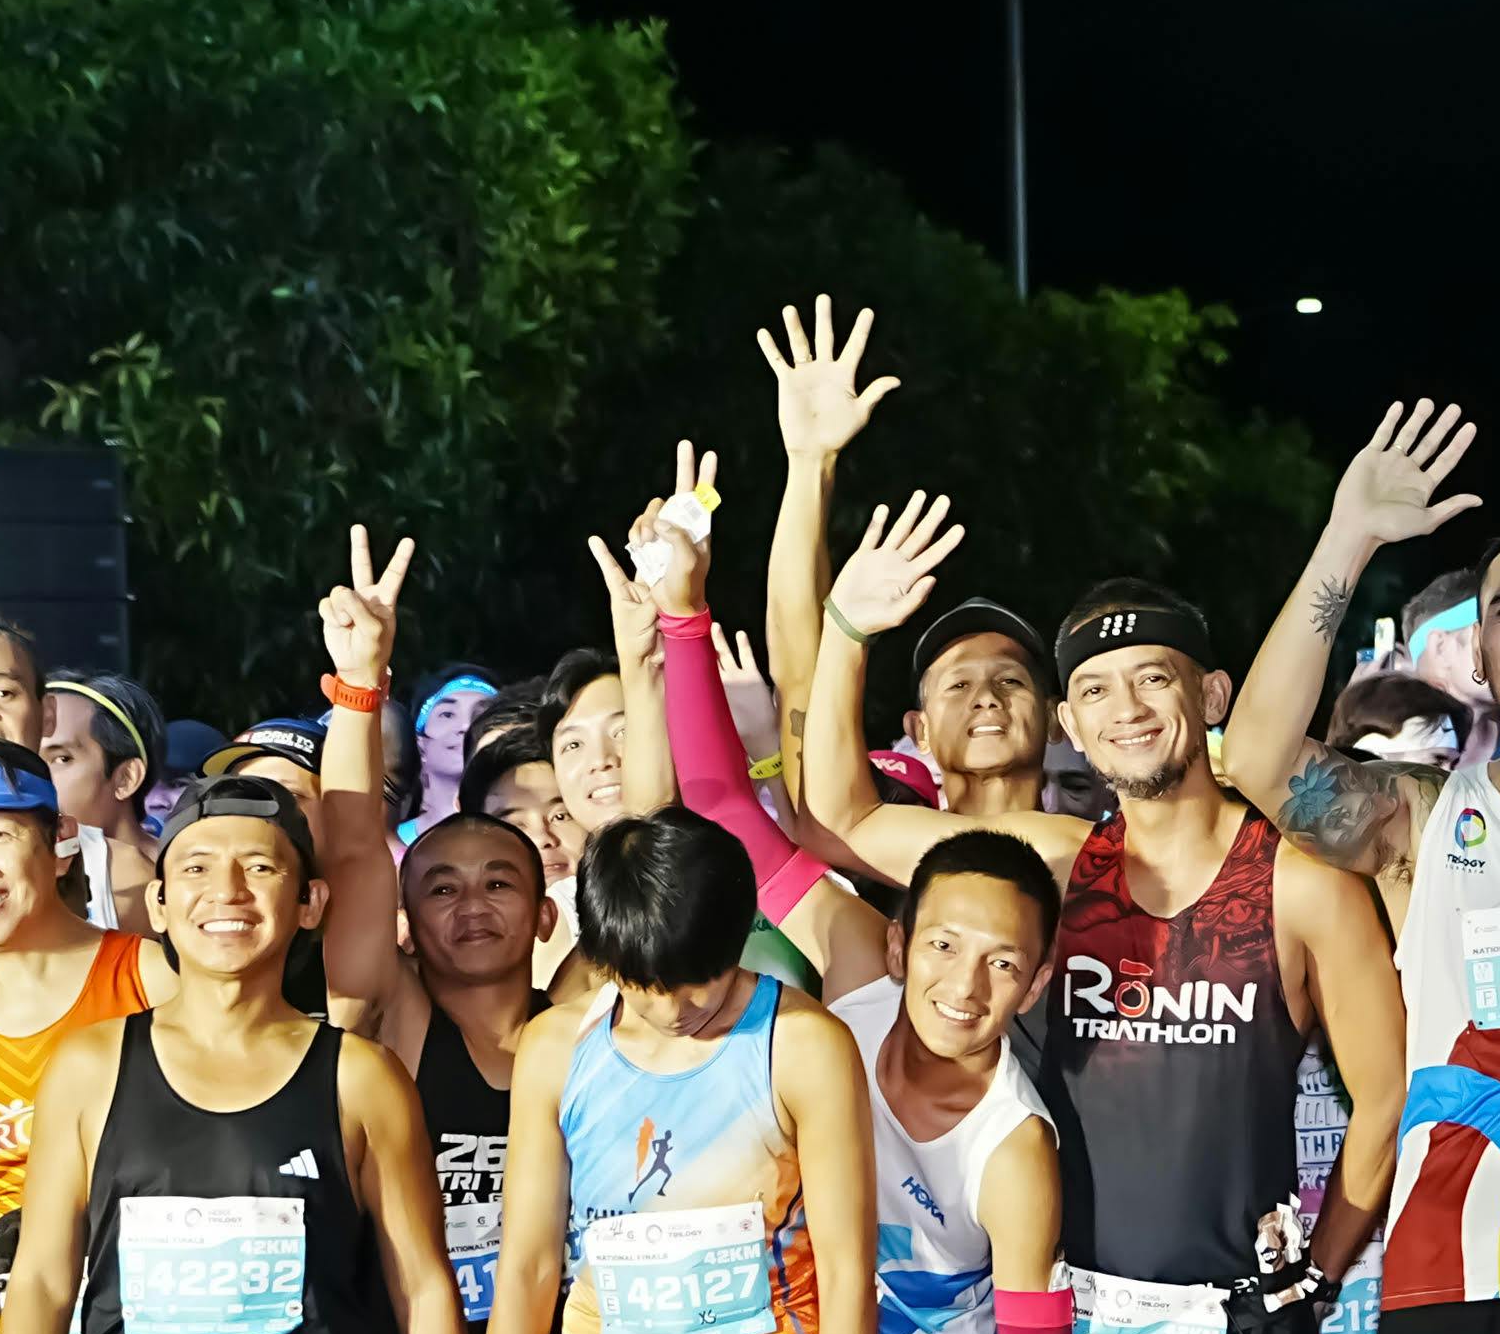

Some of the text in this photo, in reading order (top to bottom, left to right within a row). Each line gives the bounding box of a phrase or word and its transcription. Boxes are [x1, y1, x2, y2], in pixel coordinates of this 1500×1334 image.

[1072, 1018, 1236, 1045] TRIATHLON
[900, 1176, 946, 1227] HOKA
[240, 1240, 300, 1255] 42KM
[703, 1244, 761, 1266] 42KM
[147, 1260, 301, 1295] 42232
[627, 1262, 761, 1313] 42127
